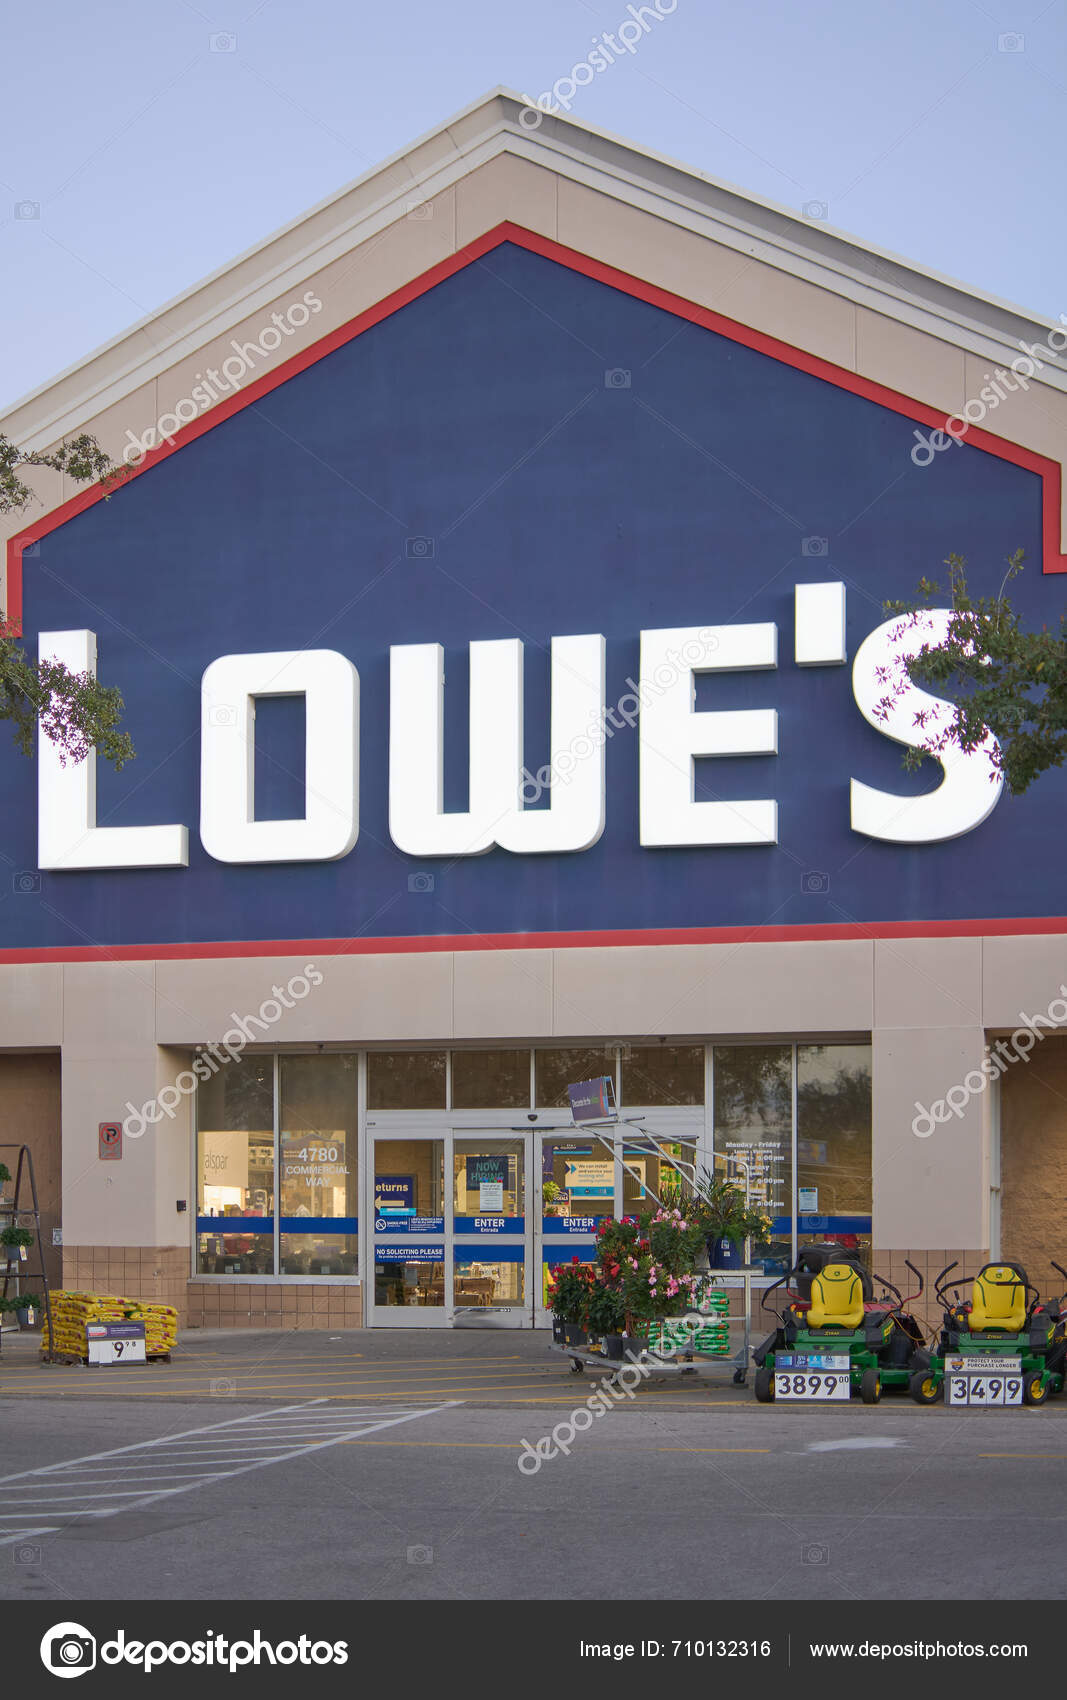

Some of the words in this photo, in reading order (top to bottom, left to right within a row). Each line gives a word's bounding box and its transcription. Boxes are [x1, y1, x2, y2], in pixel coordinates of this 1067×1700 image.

[38, 581, 1004, 870] LOWE'S
[298, 1147, 338, 1163] 4780
[286, 1165, 350, 1175] COMMERCIAL
[476, 1161, 500, 1172] NOW
[305, 1177, 331, 1187] WAY
[376, 1182, 409, 1193] eturns
[474, 1218, 505, 1228] ENTER
[563, 1218, 594, 1227] ENTER
